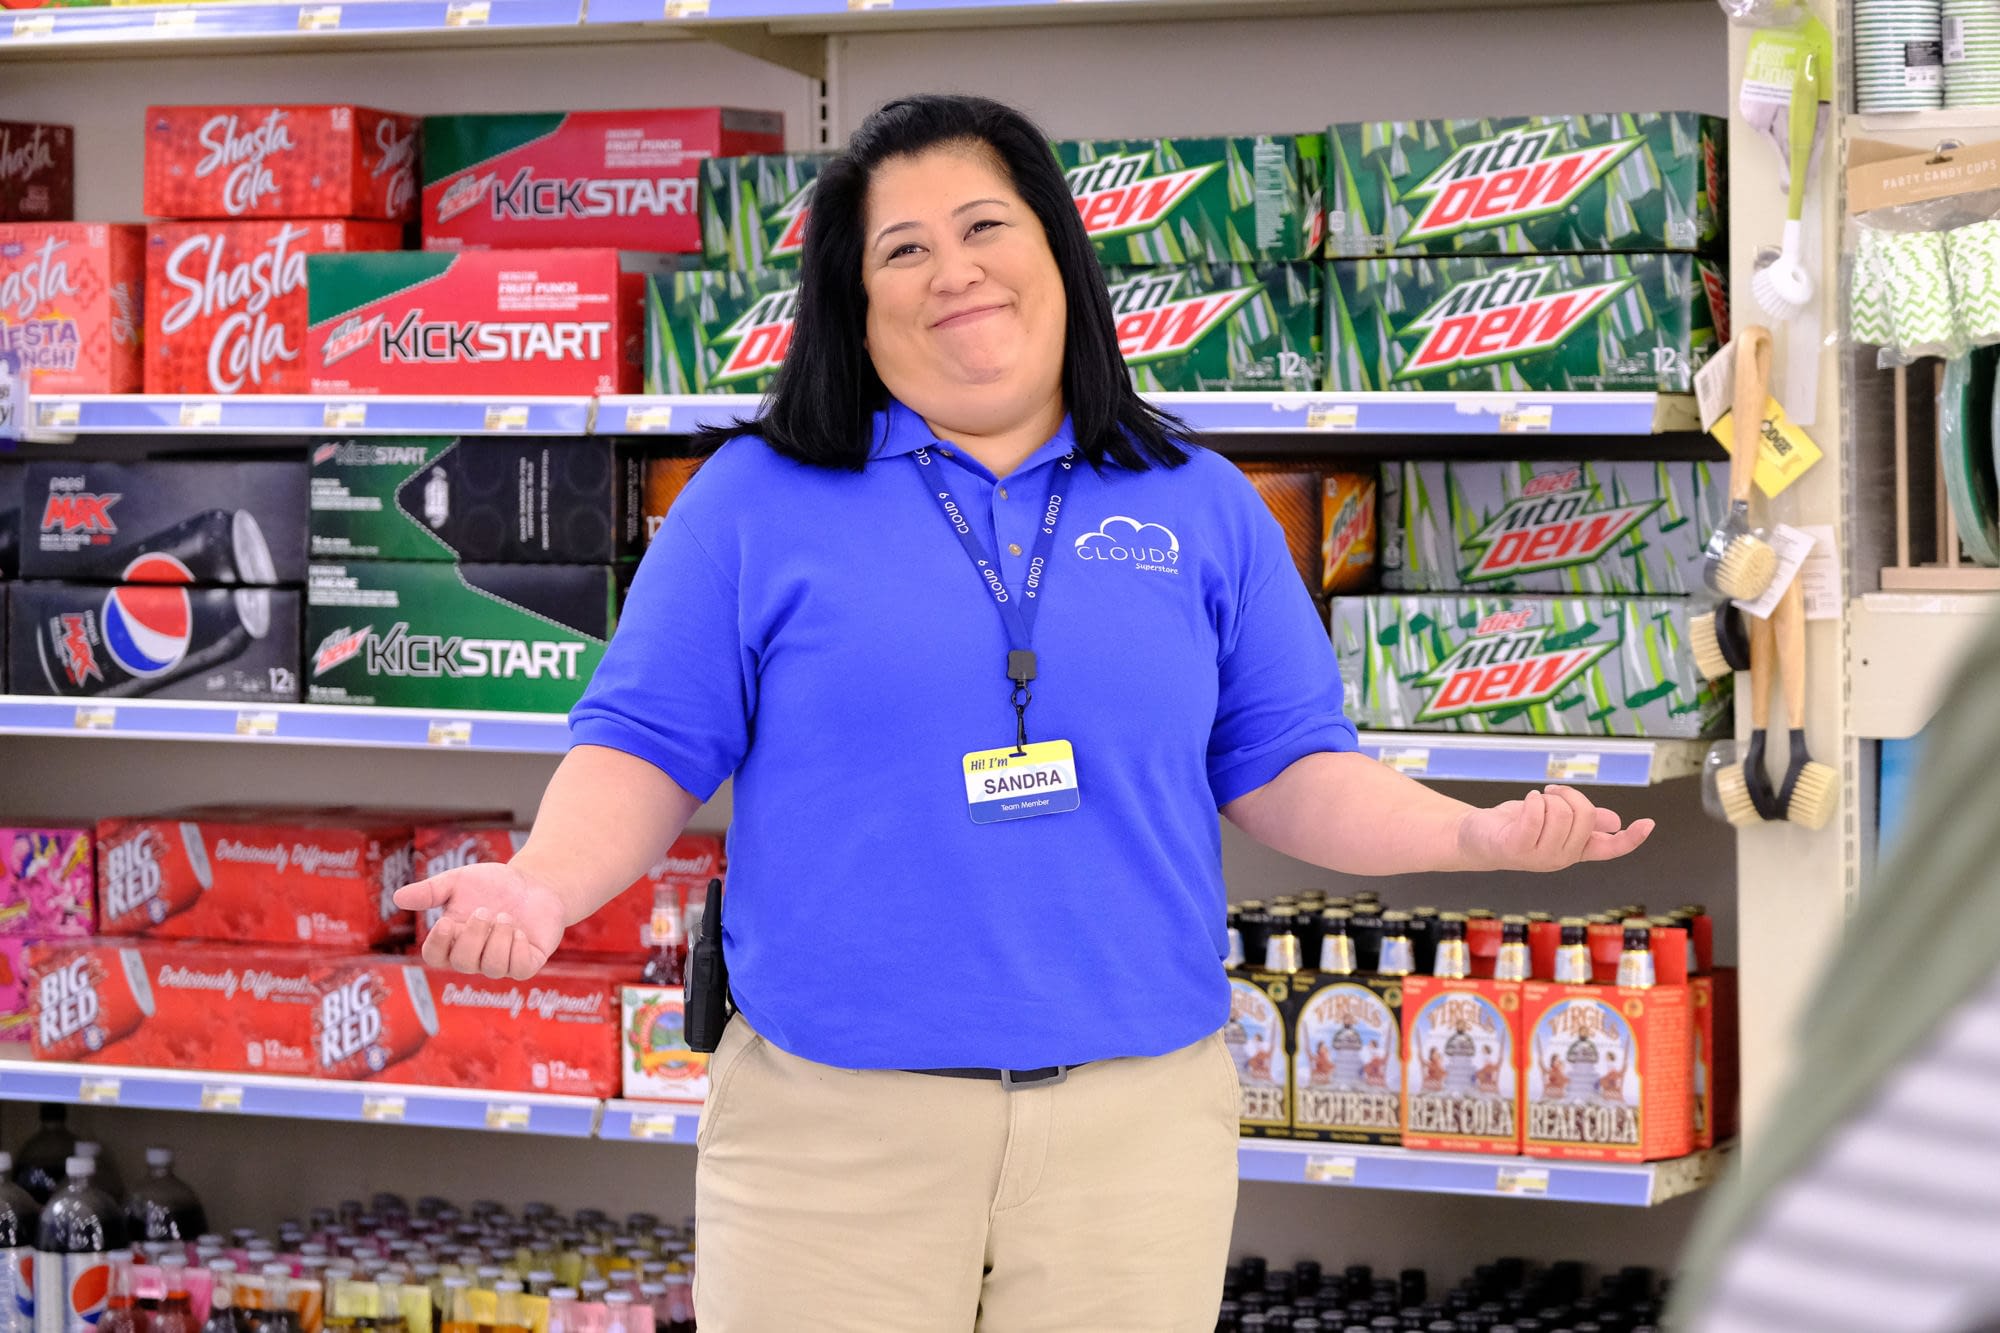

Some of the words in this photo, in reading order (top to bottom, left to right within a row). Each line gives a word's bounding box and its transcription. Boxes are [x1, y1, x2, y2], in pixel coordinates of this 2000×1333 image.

[0, 126, 56, 181] hasta
[196, 109, 296, 178] Shasta
[1434, 134, 1549, 184] Mtn
[223, 164, 281, 216] Cola
[1882, 173, 1920, 190] PARTY
[1924, 167, 1963, 182] CANDY
[1967, 159, 1997, 175] CUPS
[1074, 173, 1196, 233] ew
[0, 236, 80, 318] asta
[162, 223, 309, 335] Shasta
[1111, 276, 1173, 314] tn
[1426, 272, 1542, 320] Mtn
[0, 318, 80, 350] IESTA
[380, 308, 609, 363] KICKSTART
[1117, 293, 1234, 355] ew
[21, 345, 77, 371] NCH!
[208, 312, 299, 394] Cola
[1277, 351, 1300, 376] 12
[1652, 348, 1677, 373] 12
[915, 447, 931, 466] CLO
[944, 501, 969, 534] CLOUD
[1045, 494, 1062, 526] CLOUD
[1491, 496, 1582, 532] Mtn
[983, 569, 1009, 603] CLOUD
[1027, 557, 1044, 588] CLOUD
[1135, 562, 1179, 575] Superstore
[367, 621, 586, 680] KICKSTART
[1441, 637, 1534, 673] Mtn
[268, 667, 289, 694] 12
[971, 760, 985, 771] Hi!
[989, 757, 1008, 769] I'm
[984, 769, 1062, 795] SANDRA
[1021, 799, 1050, 809] Member
[108, 829, 152, 880] BIG
[108, 859, 160, 919] RED
[40, 955, 89, 1010] BIG
[323, 973, 371, 1028] BIG
[40, 987, 98, 1047] RED
[322, 1005, 380, 1068] RED
[1240, 1087, 1285, 1120] EER
[1409, 1098, 1459, 1132] REAL
[1460, 1100, 1513, 1136] COLA
[1529, 1103, 1582, 1140] REAL
[1583, 1106, 1638, 1144] COLA
